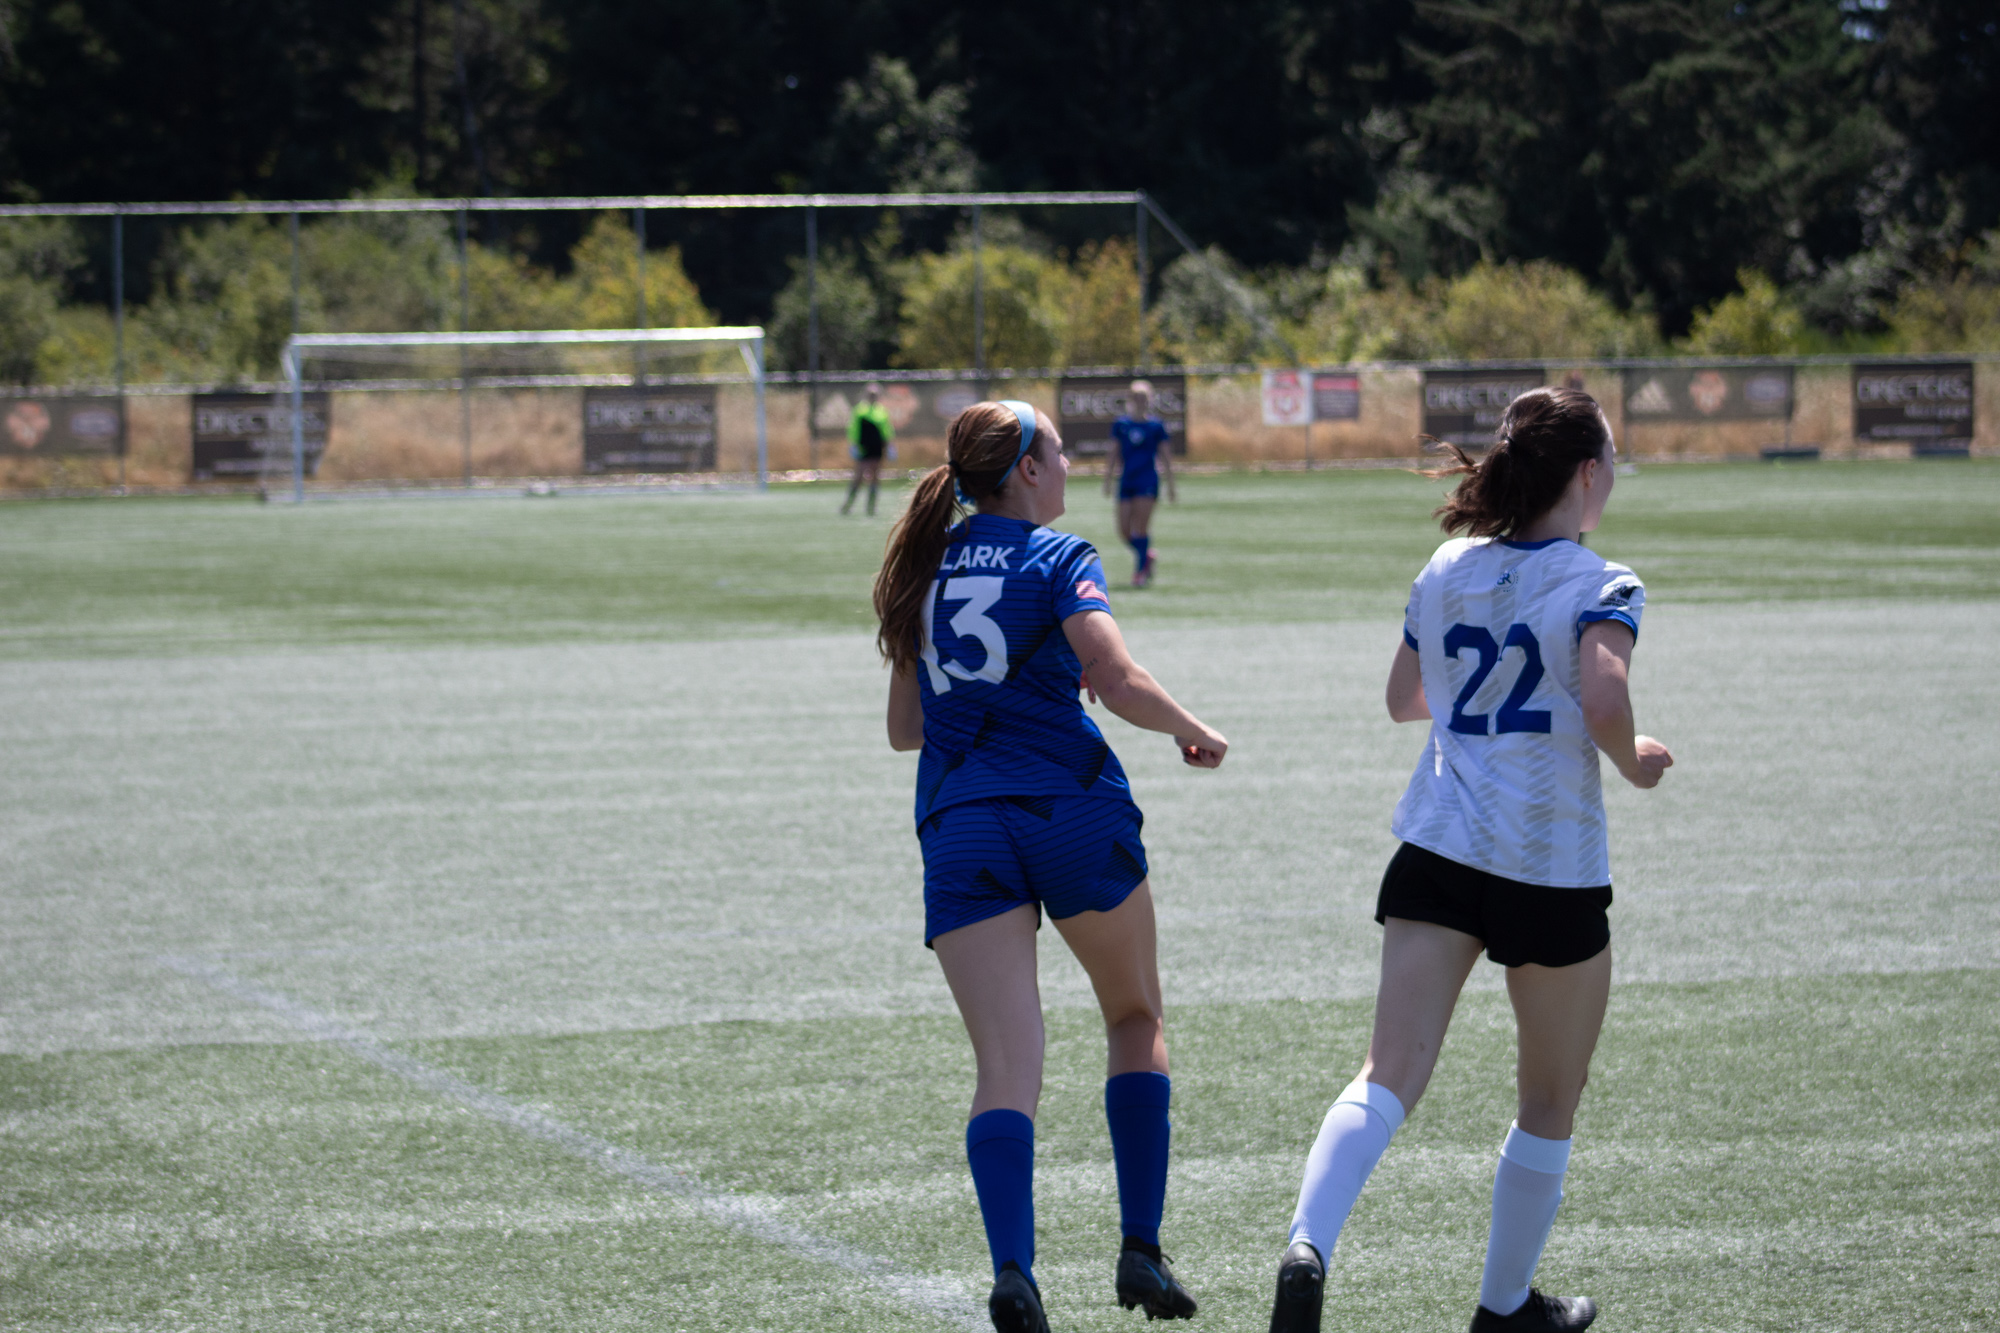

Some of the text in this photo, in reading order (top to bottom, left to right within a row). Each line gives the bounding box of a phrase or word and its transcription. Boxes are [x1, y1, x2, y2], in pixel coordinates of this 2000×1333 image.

[937, 545, 1015, 571] LARK
[920, 575, 1009, 696] 13
[1443, 622, 1552, 736] 22
